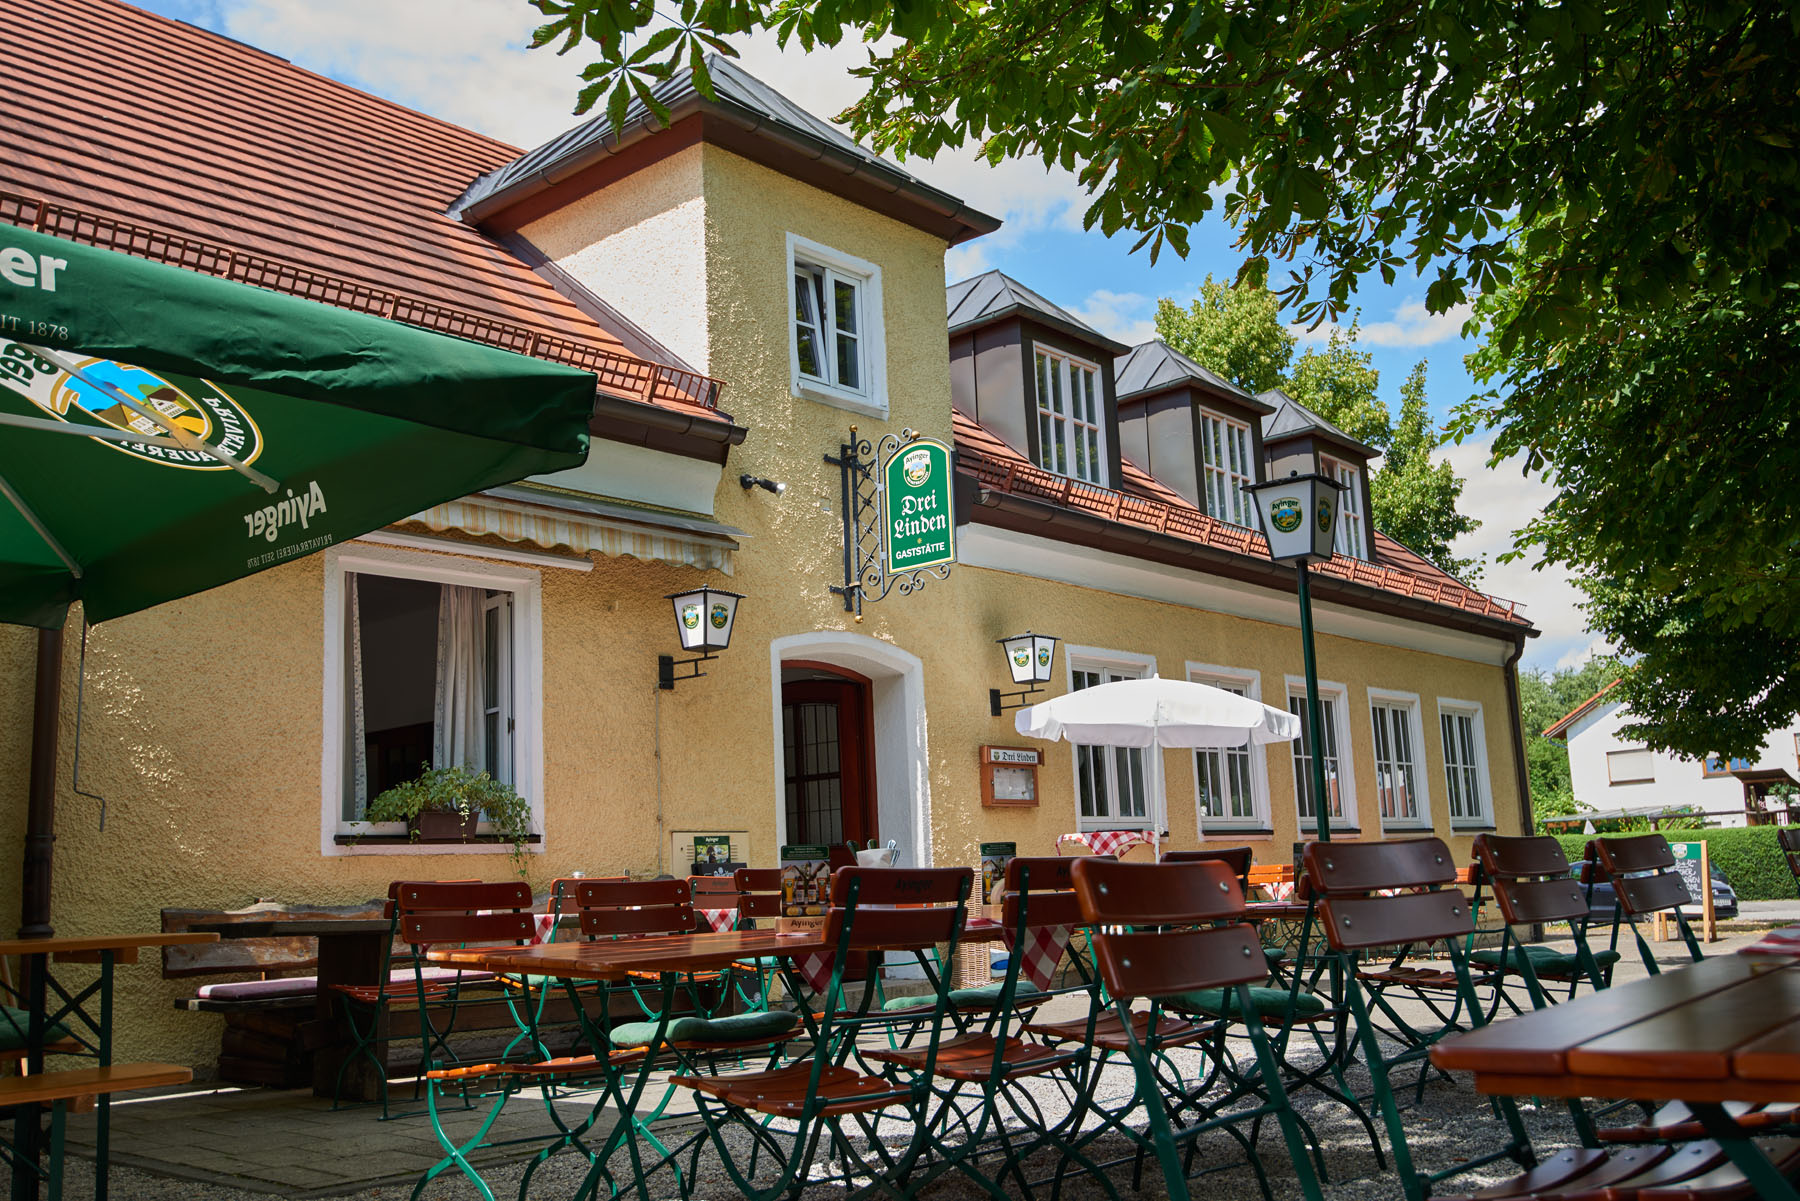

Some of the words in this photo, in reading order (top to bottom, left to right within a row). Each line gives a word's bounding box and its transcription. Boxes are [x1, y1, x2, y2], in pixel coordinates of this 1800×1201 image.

[29, 320, 69, 340] 1878
[905, 453, 929, 464] Ayinger
[901, 489, 938, 516] Drei
[1272, 500, 1298, 511] Ayinger
[894, 513, 946, 538] Linden
[896, 542, 945, 560] GASTSTÄTTE
[790, 919, 824, 928] Ayinger
